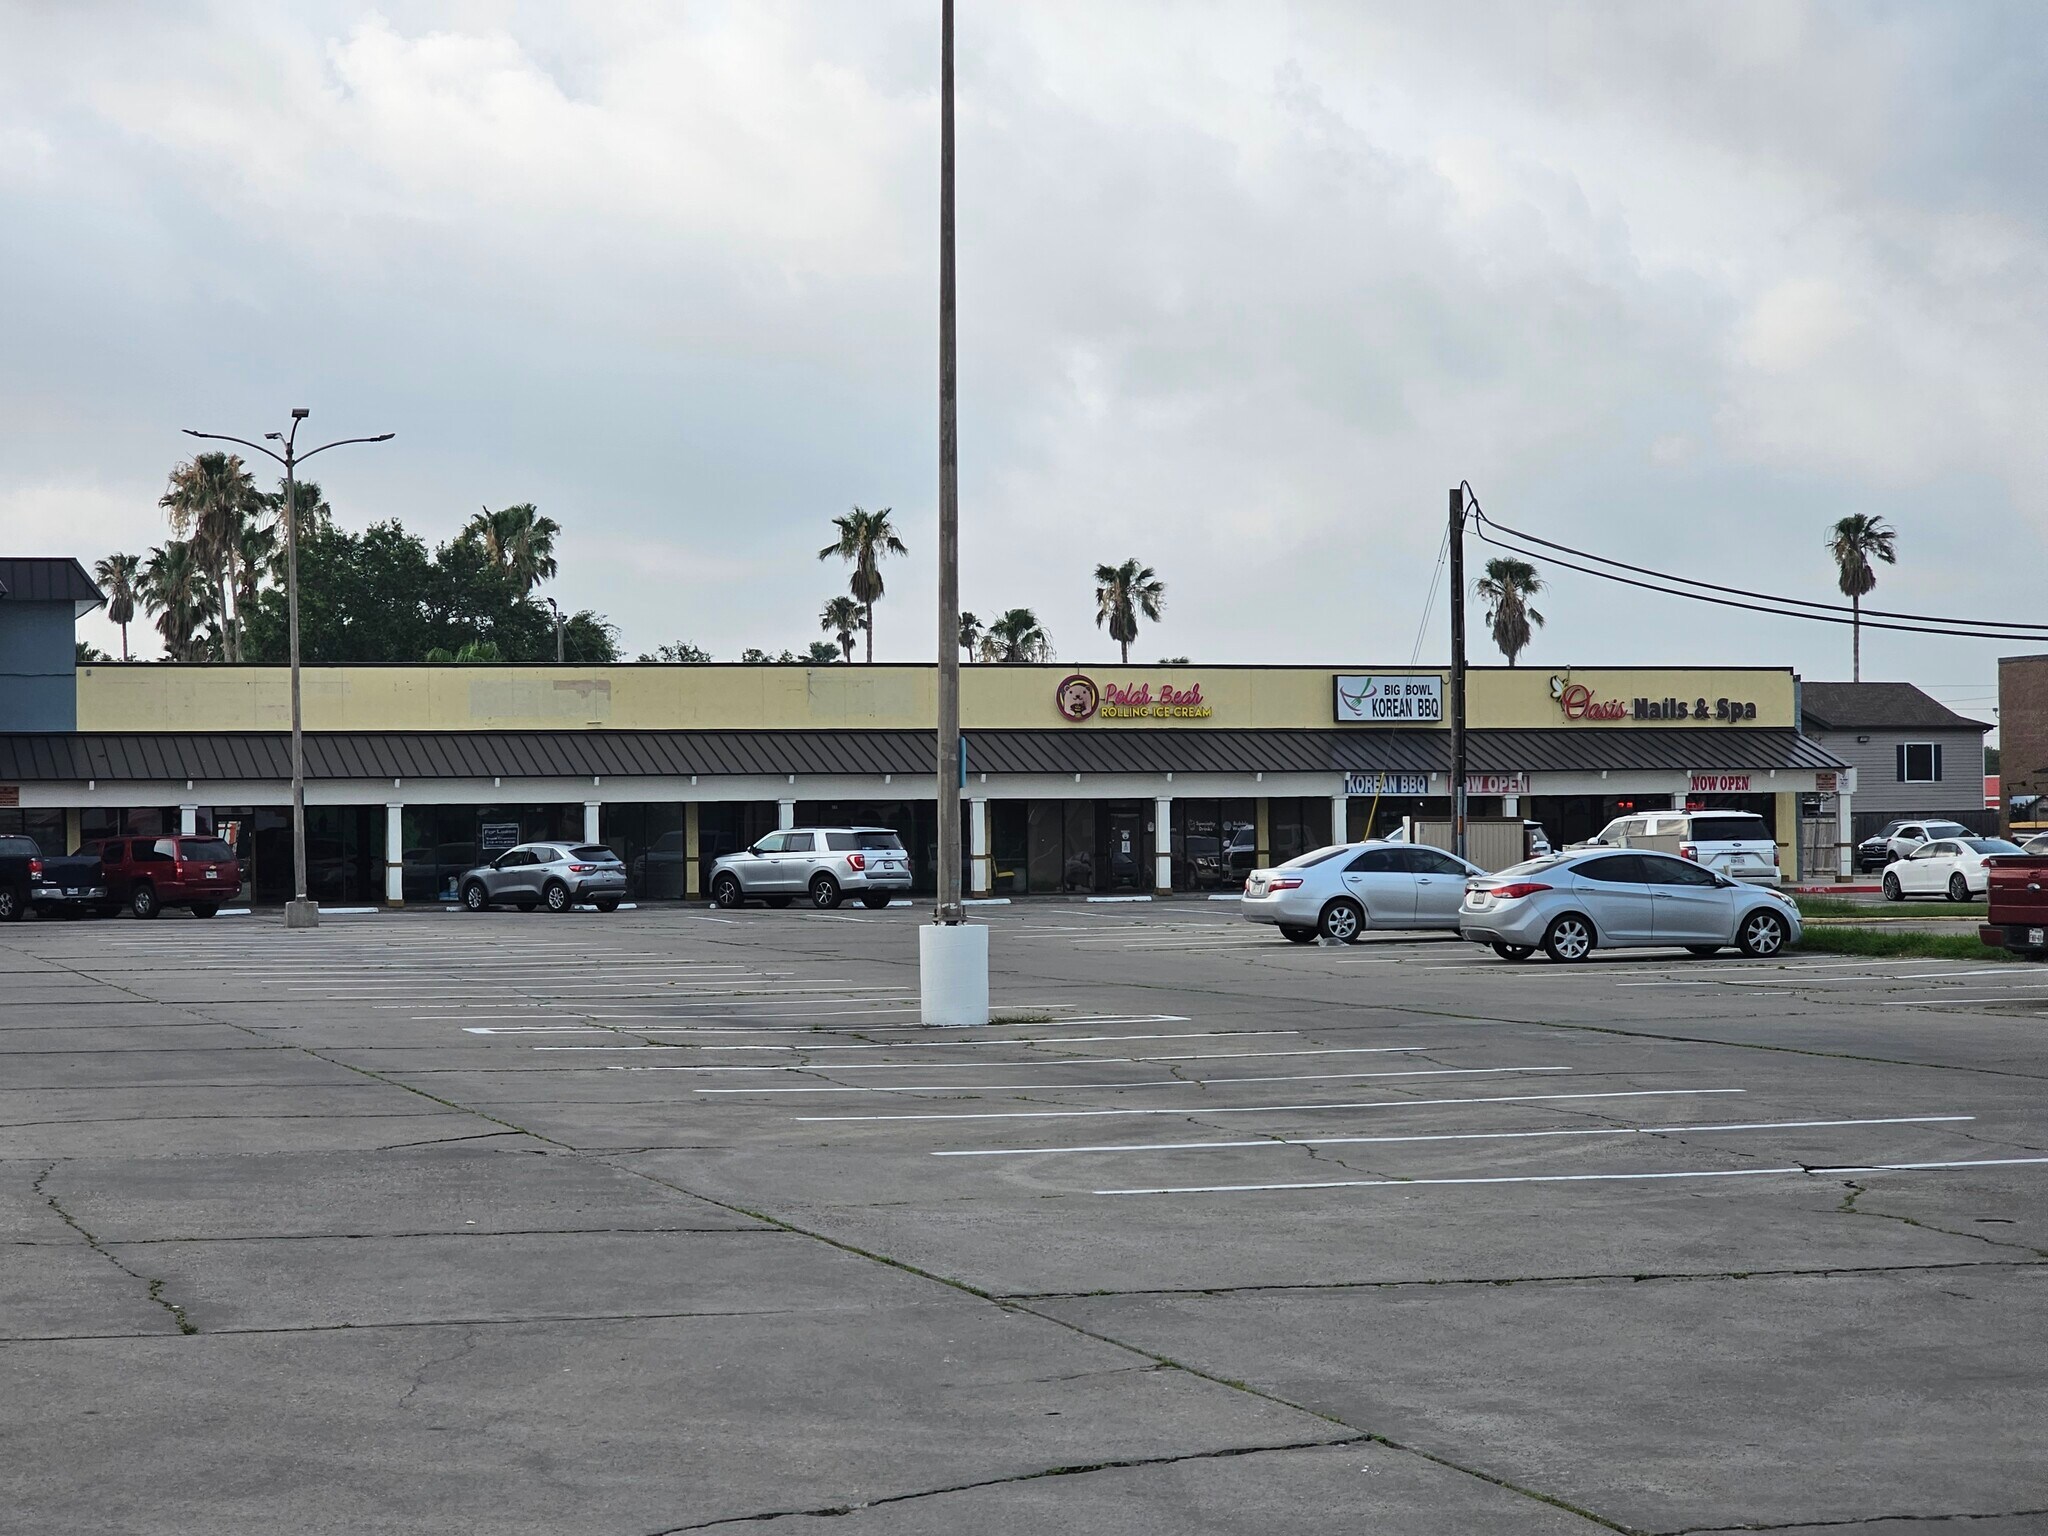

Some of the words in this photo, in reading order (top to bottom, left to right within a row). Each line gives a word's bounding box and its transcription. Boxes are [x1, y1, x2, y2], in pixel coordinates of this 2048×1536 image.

[1105, 683, 1152, 705] Polar
[1160, 684, 1203, 705] Bear
[1384, 684, 1400, 695] BIG
[1406, 684, 1433, 695] BOWL
[1101, 707, 1149, 717] ROLLING
[1153, 707, 1170, 717] ICE
[1174, 707, 1212, 717] CREAM
[1372, 698, 1412, 717] KOREAN
[1418, 698, 1439, 717] BBQ
[1563, 684, 1628, 720] Oasis
[1632, 697, 1688, 720] Nails
[1693, 697, 1711, 720] &
[1715, 697, 1757, 723] Spa
[1348, 776, 1397, 793] KOREAN
[1401, 776, 1426, 793] BBQ
[1488, 776, 1528, 793] OPEN
[1691, 776, 1718, 791] NOW
[1720, 776, 1750, 791] OPEN
